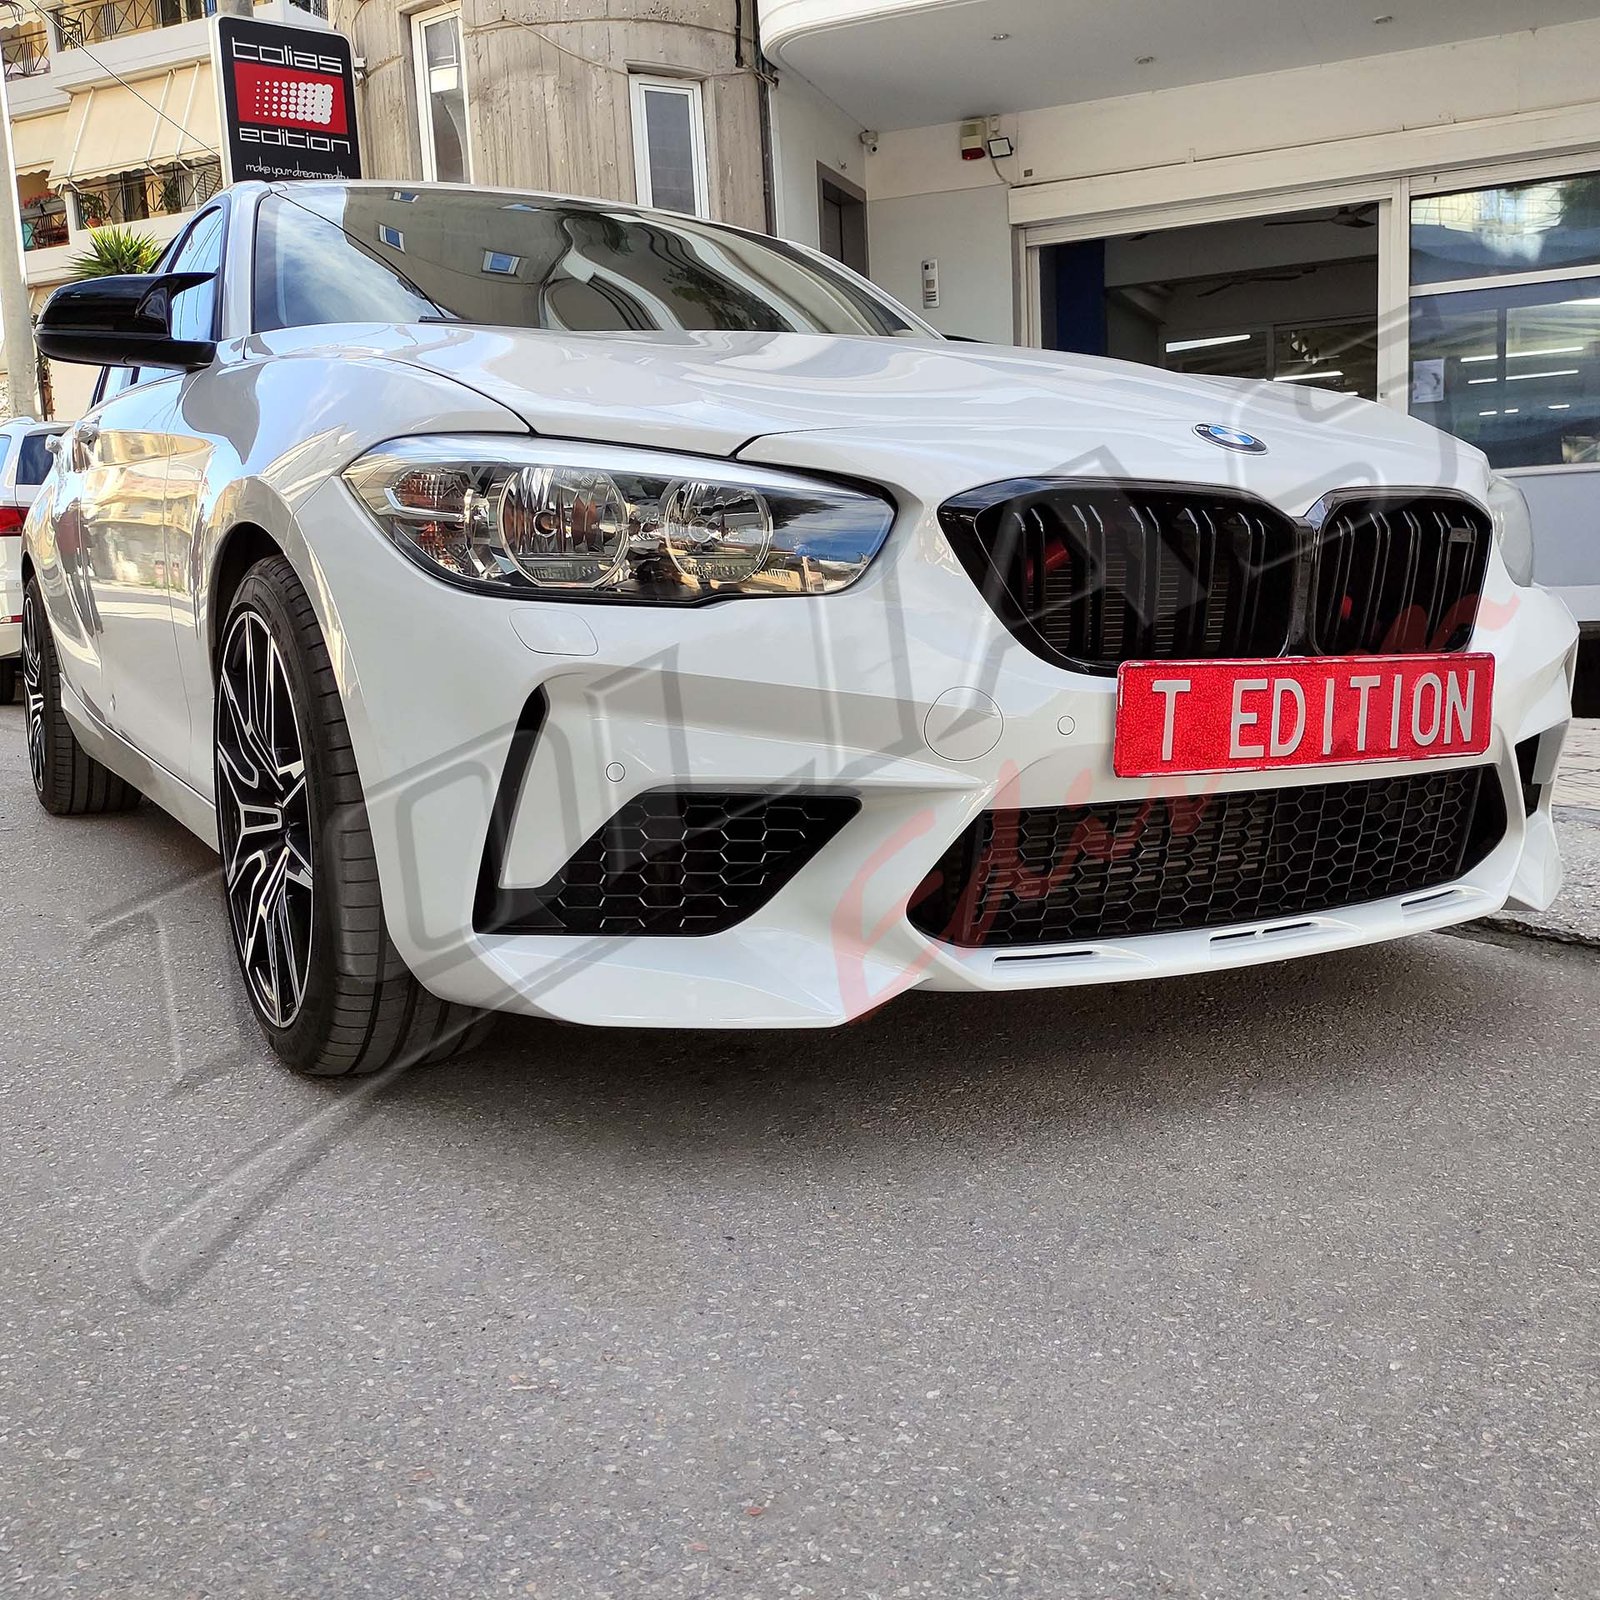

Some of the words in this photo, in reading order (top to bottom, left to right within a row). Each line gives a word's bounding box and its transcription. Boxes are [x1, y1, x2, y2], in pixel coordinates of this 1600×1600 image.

[231, 37, 343, 74] tolias
[239, 128, 351, 154] edition
[245, 155, 271, 175] make
[271, 165, 292, 178] your
[292, 160, 323, 179] dream
[1152, 679, 1191, 761] T
[1229, 670, 1476, 759] EDITION
